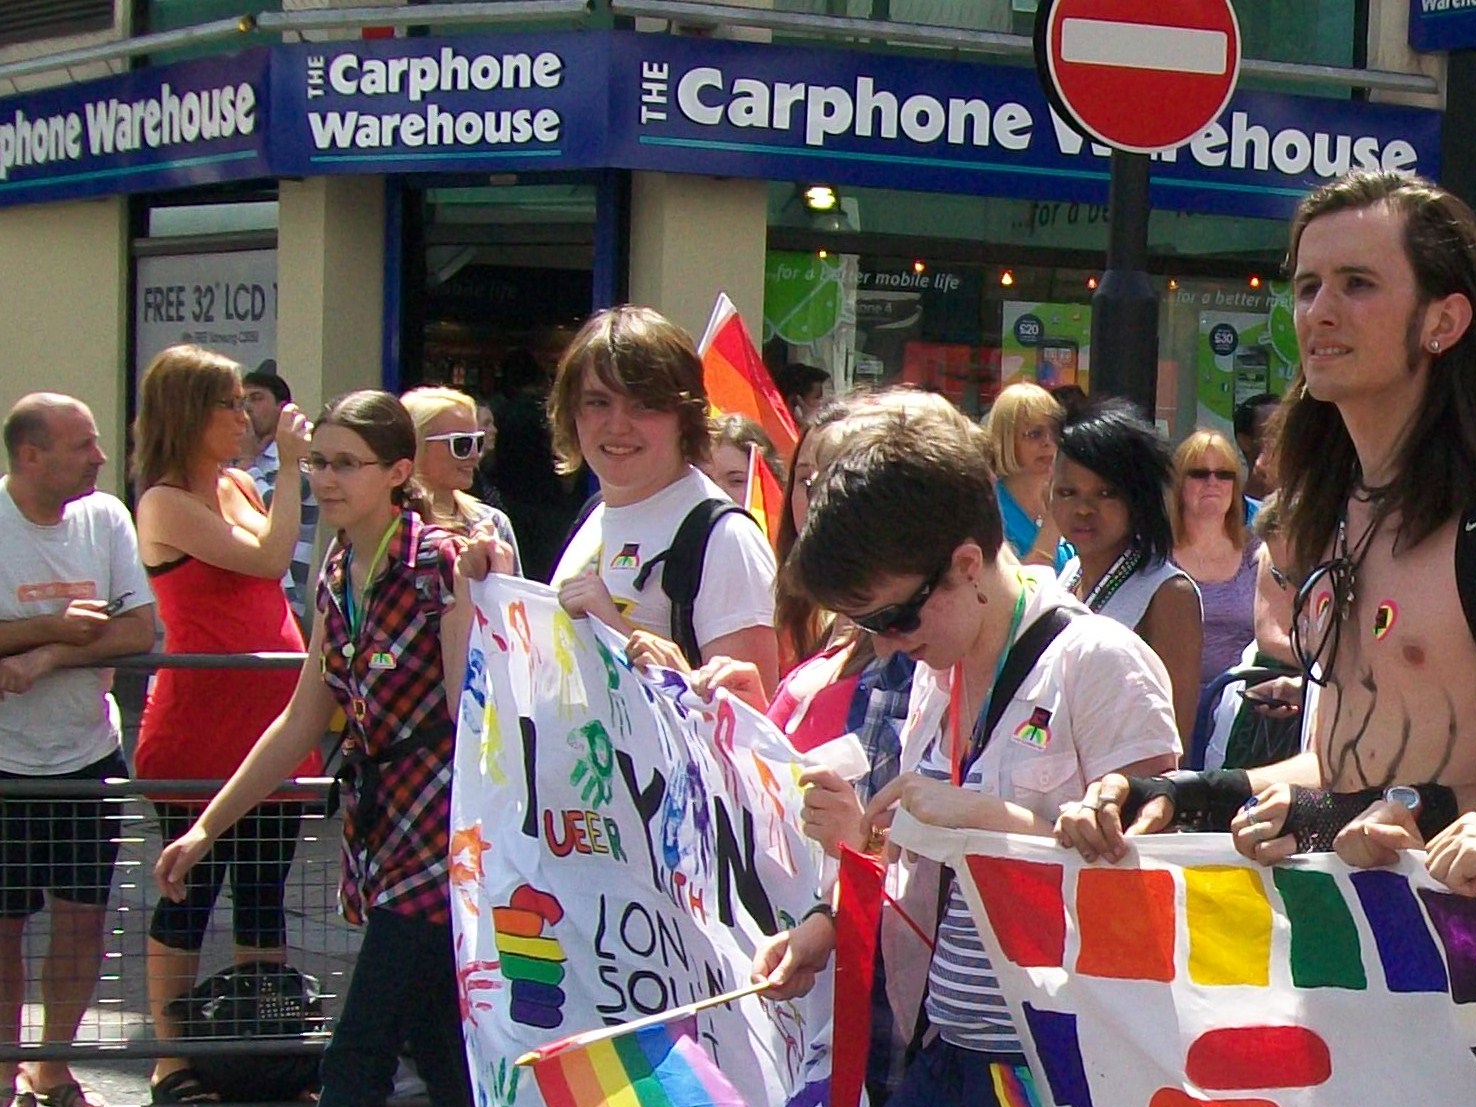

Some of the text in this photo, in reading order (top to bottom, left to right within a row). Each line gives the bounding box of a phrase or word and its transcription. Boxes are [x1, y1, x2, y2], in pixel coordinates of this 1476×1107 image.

[307, 47, 563, 101] THE Carphone
[85, 82, 257, 155] Warehouse
[308, 104, 561, 149] Warehouse
[641, 61, 1419, 177] THE Carphone ehouse
[144, 285, 186, 323] FREE
[225, 282, 266, 322] LCD
[874, 271, 930, 290] mobile
[934, 273, 961, 294] life
[1216, 289, 1261, 308] better
[1019, 323, 1040, 336] £20
[1213, 332, 1234, 345] £30
